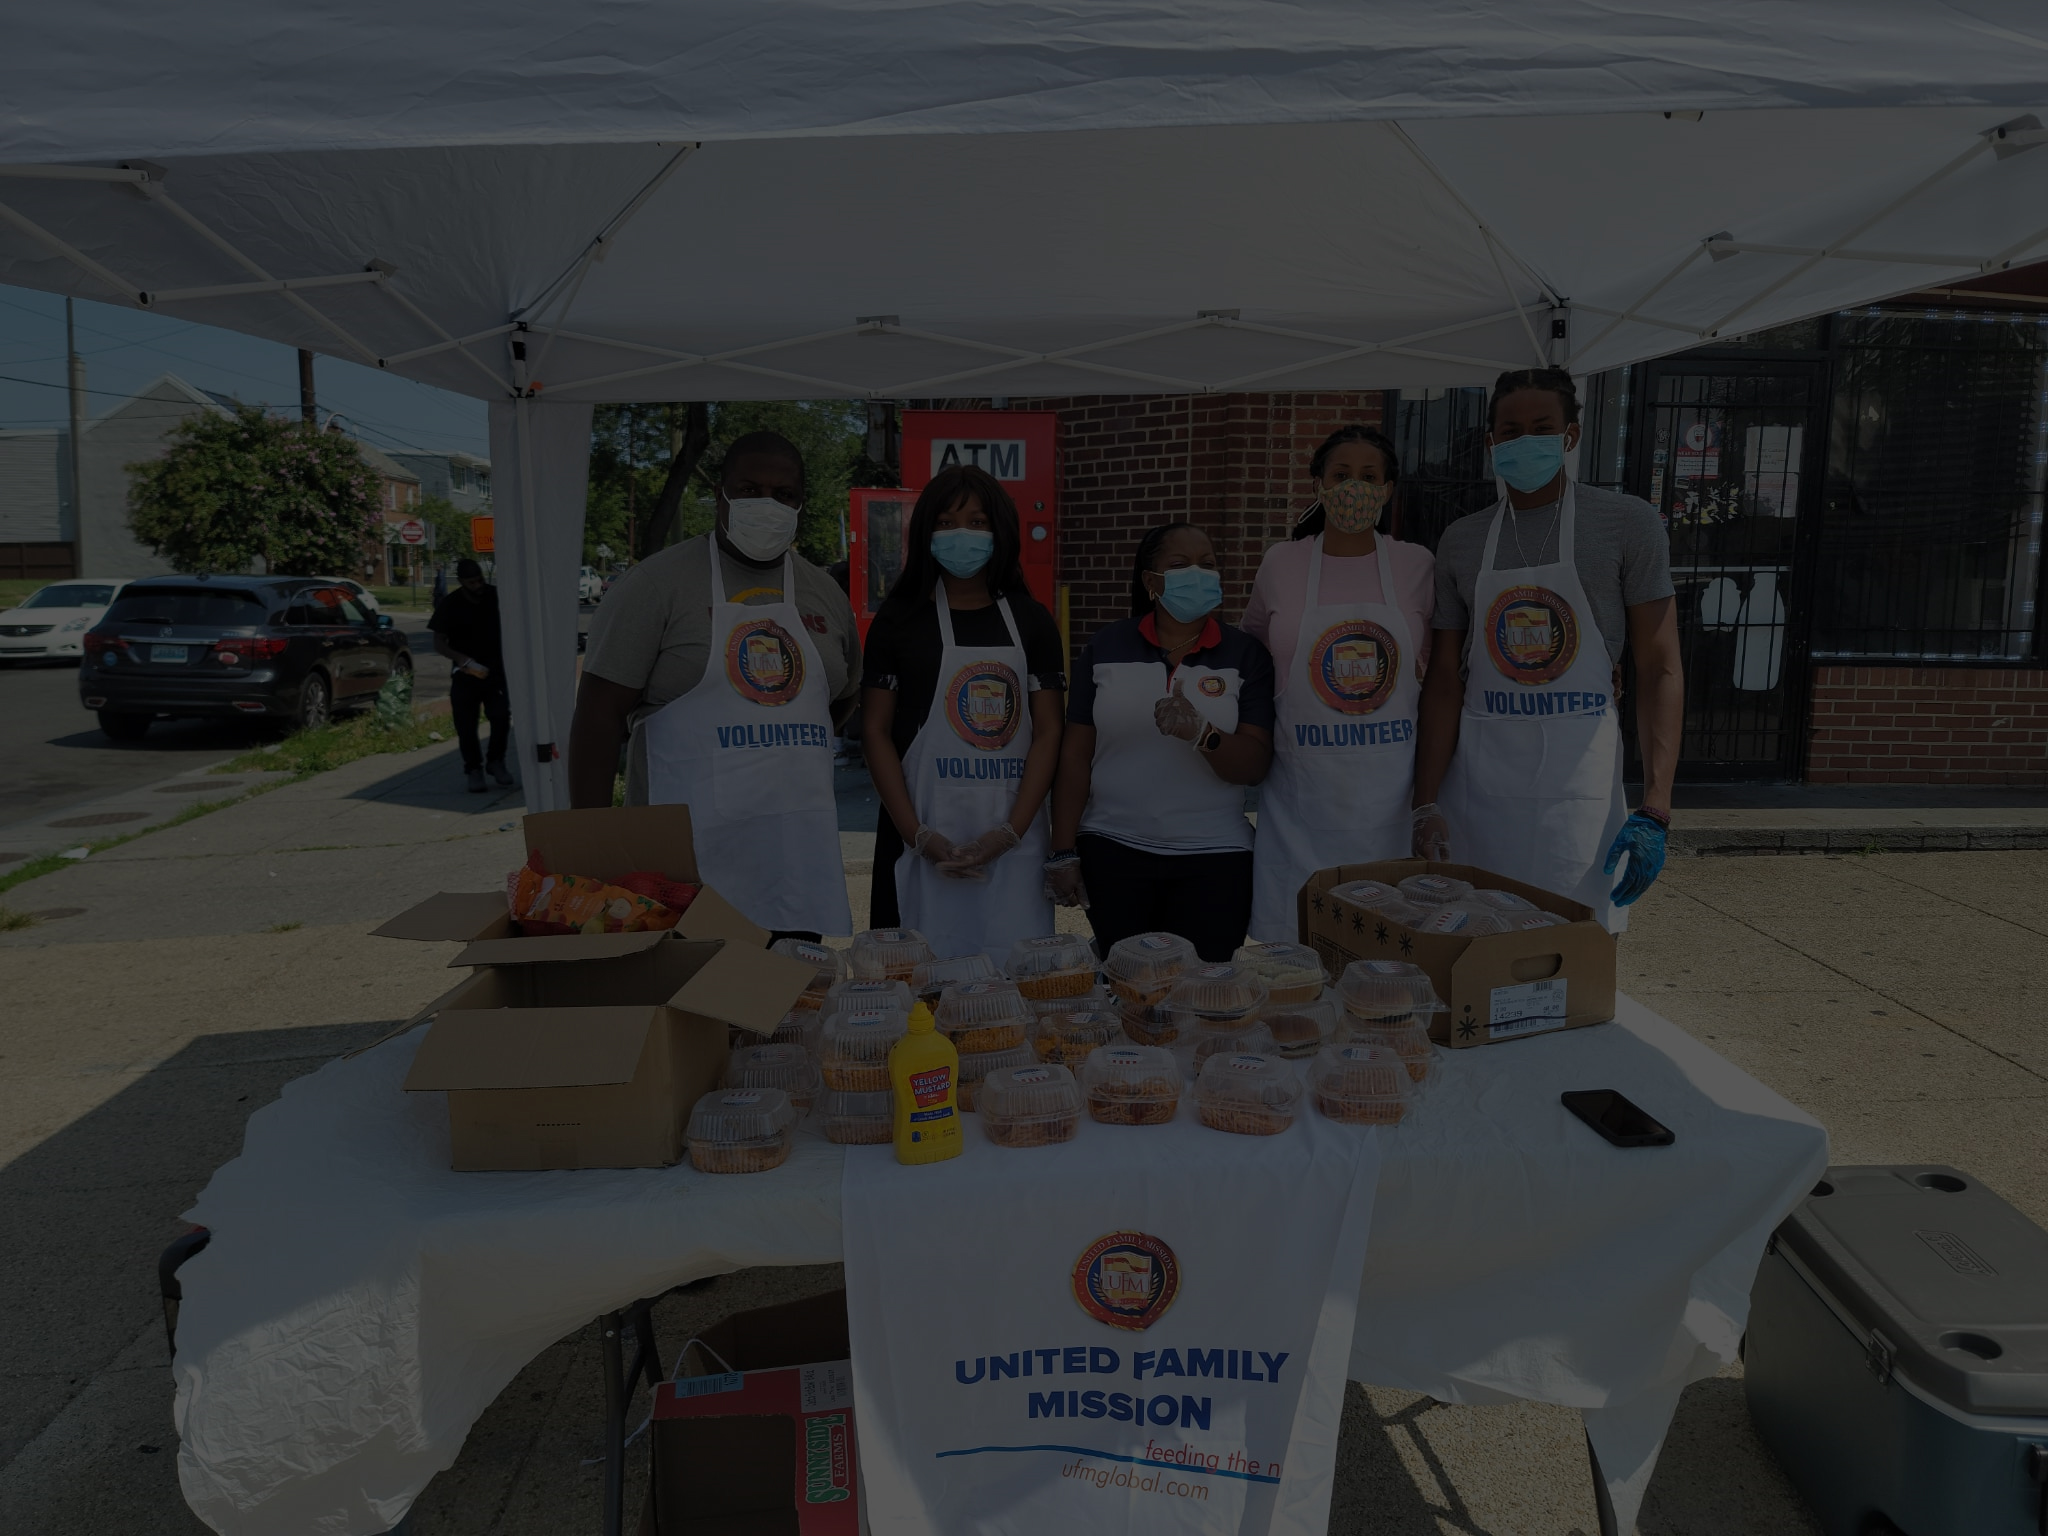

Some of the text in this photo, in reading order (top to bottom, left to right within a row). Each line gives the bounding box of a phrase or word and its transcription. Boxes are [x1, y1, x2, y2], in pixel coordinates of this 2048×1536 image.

[938, 443, 1019, 477] ATM
[1541, 593, 1571, 623] MISSION
[1335, 624, 1367, 636] FAMILY
[1368, 626, 1396, 656] MISSION
[972, 664, 1001, 674] FAMILY
[1484, 690, 1607, 717] VOLUNTEER
[717, 723, 828, 748] VOLUNTEER
[1295, 719, 1413, 747] VOLUNTEER
[936, 757, 1025, 780] VOLUNTEE
[913, 1074, 946, 1087] YELLOW
[914, 1081, 951, 1096] MUSTARD
[1079, 1235, 1174, 1272] UNITED FAMILY MISSION
[1108, 1272, 1144, 1295] UFM
[955, 1346, 1290, 1385] UNITED FAMILY
[1028, 1390, 1212, 1431] MISSION
[805, 1413, 851, 1504] SUNNYSIDE
[834, 1432, 843, 1478] FARMS
[1145, 1439, 1220, 1473] feeding
[1227, 1450, 1261, 1476] the
[1061, 1459, 1209, 1501] ufmglobal.com
